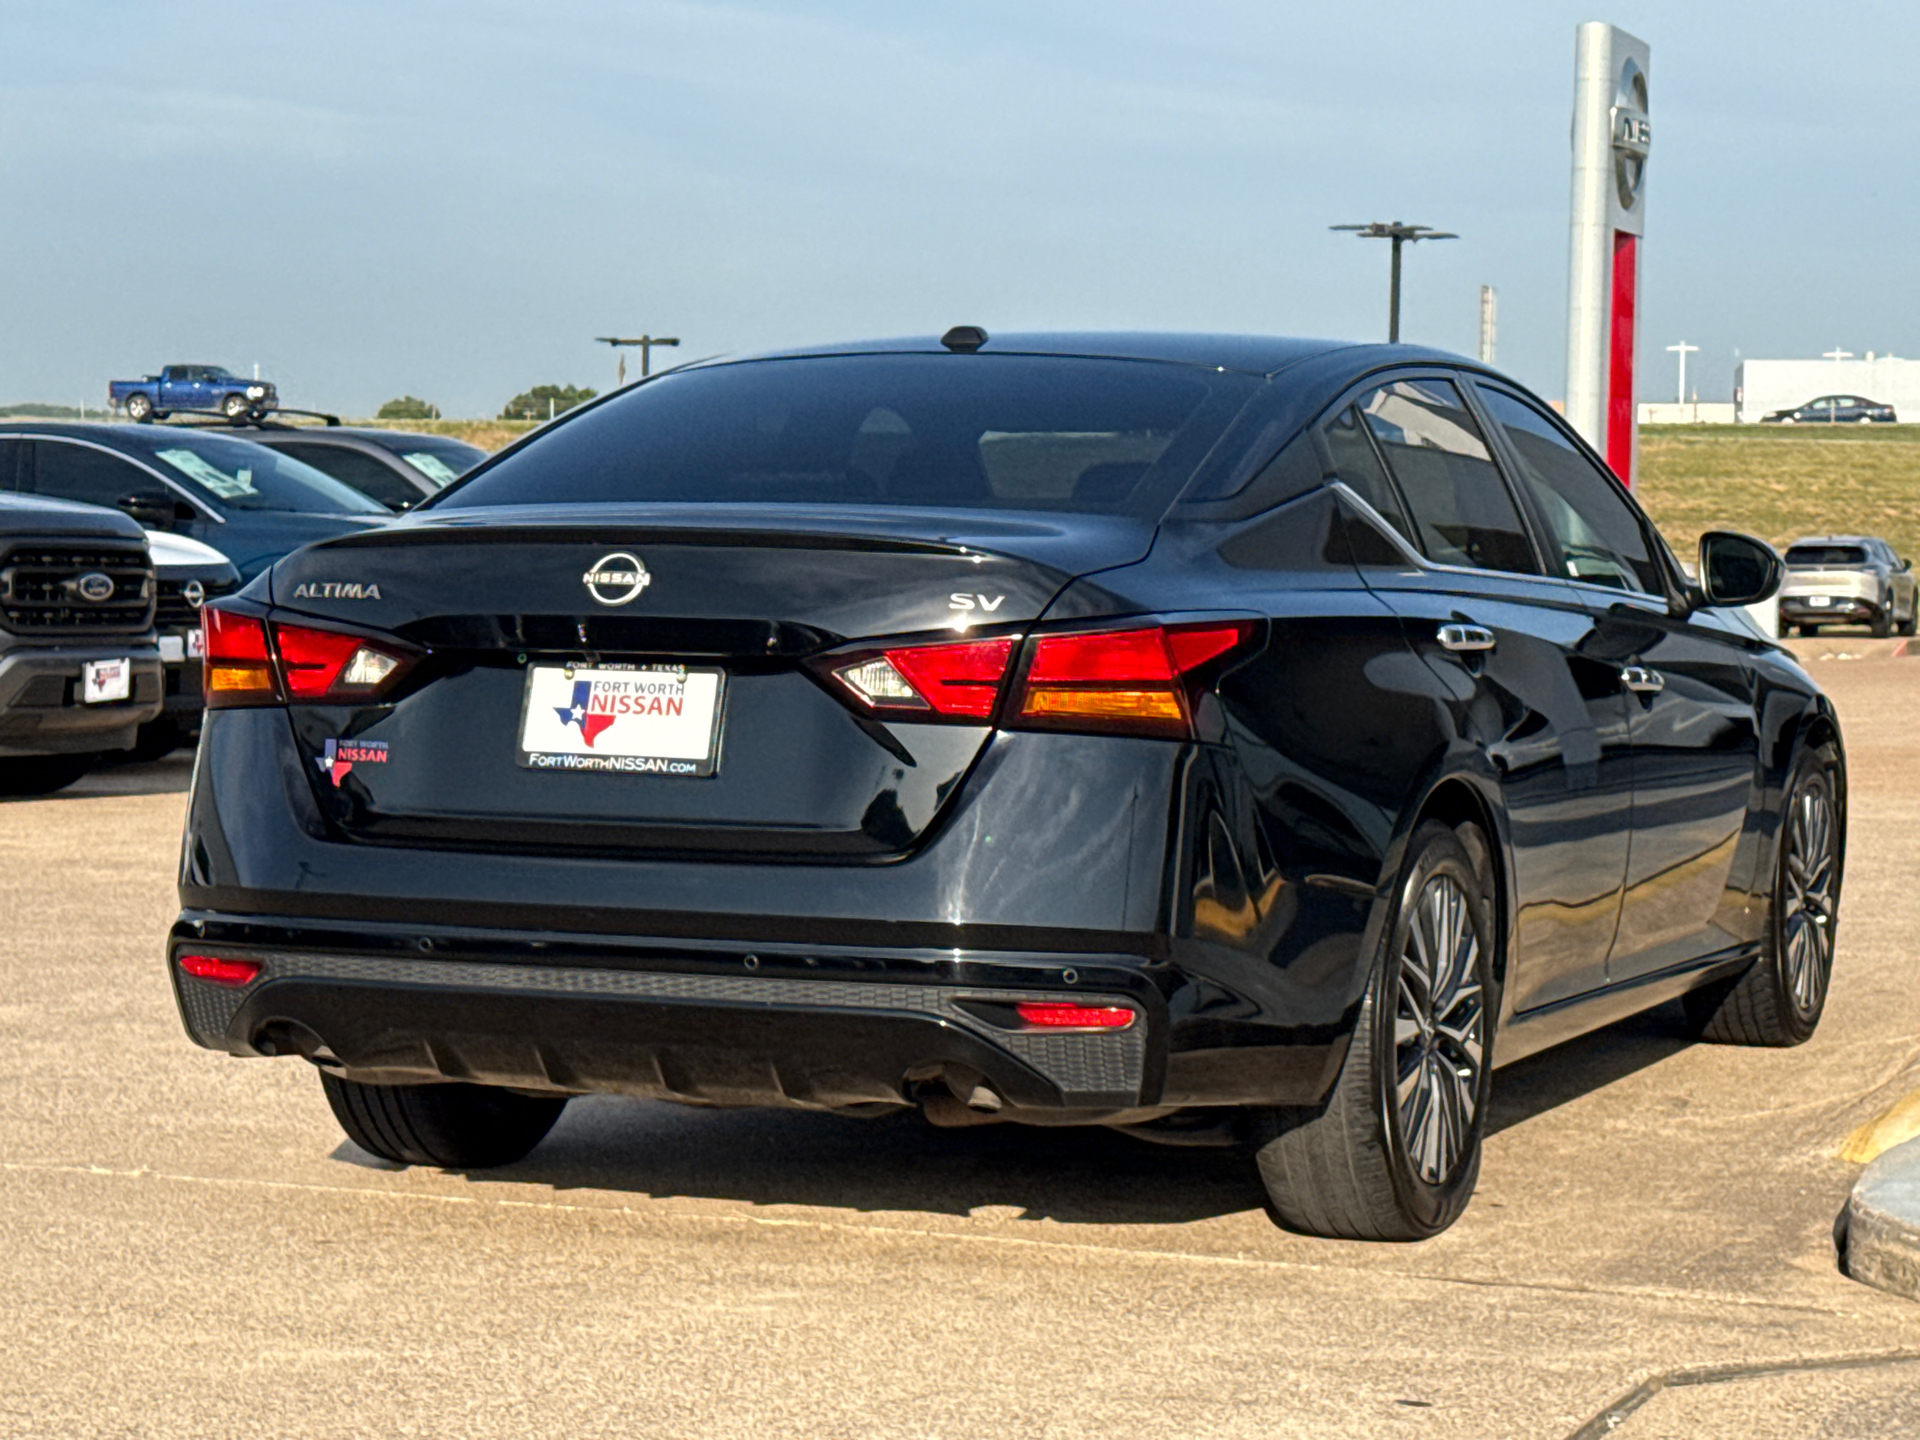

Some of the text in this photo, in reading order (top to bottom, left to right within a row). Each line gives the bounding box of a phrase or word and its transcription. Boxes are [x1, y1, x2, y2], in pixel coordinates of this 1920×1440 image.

[583, 569, 650, 586] NISSAN
[293, 583, 381, 600] ALTIMA
[949, 593, 1006, 611] SV
[598, 662, 636, 671] WORTH
[652, 663, 685, 673] TEXAS
[593, 680, 685, 696] FORT WORTH
[591, 694, 684, 716] NISSAN
[337, 748, 388, 763] NISSAN
